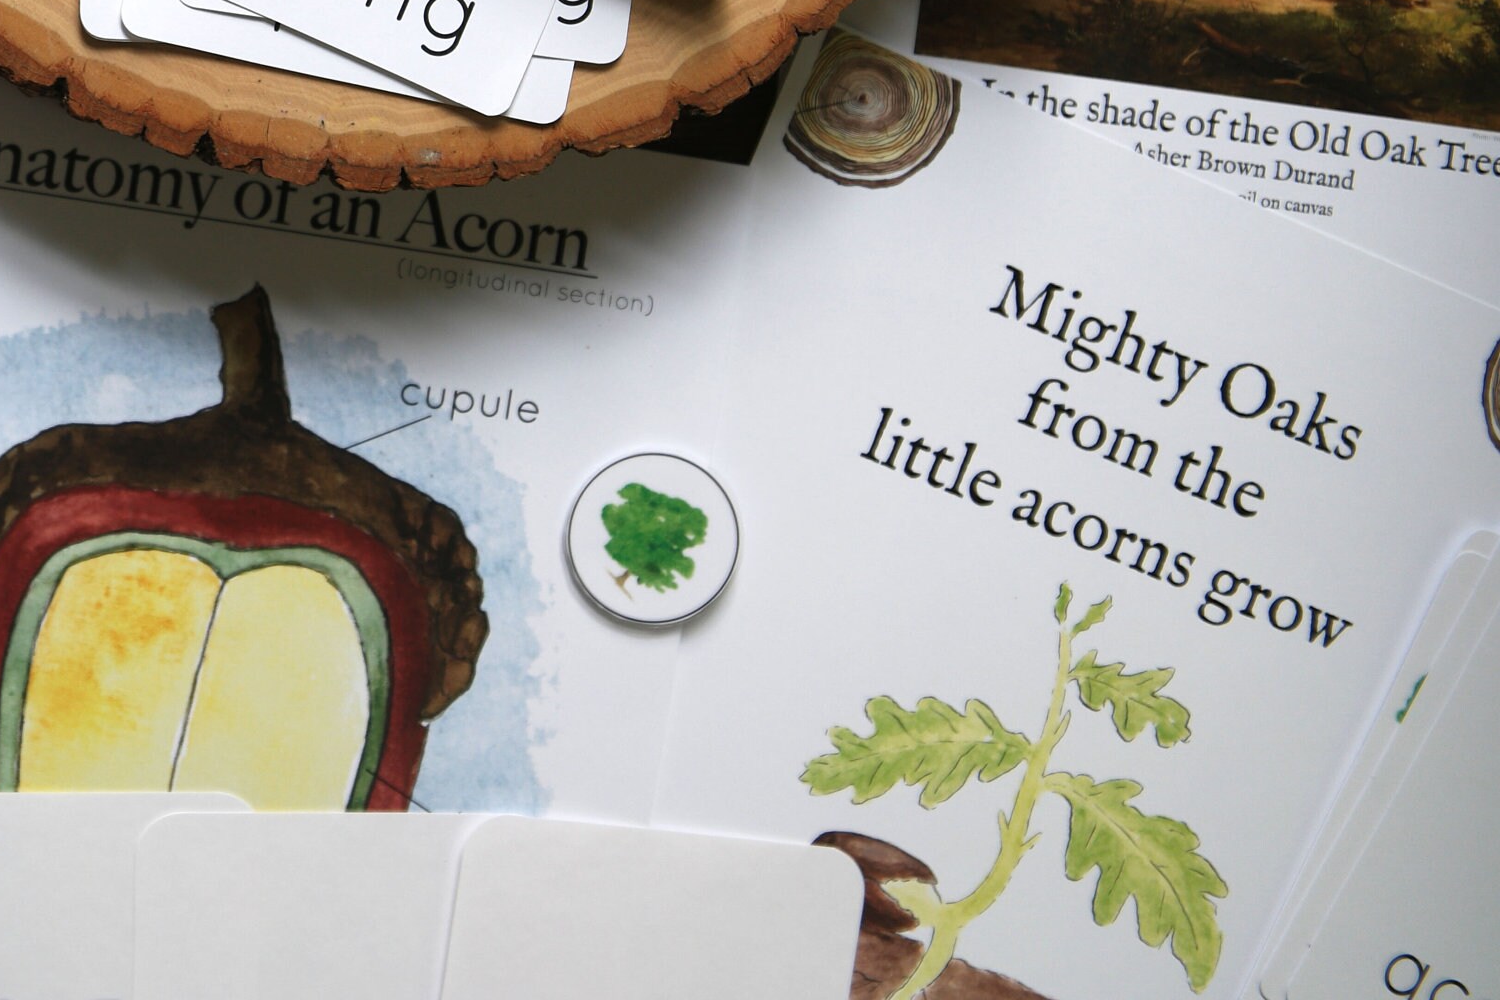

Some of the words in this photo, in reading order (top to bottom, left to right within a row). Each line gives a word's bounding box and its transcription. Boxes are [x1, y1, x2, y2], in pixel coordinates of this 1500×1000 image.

[1027, 84, 1078, 119] the
[1087, 93, 1176, 133] shade
[1185, 108, 1228, 139] of
[1229, 112, 1279, 147] the
[1289, 119, 1351, 157] Old
[1360, 129, 1427, 168] Oak
[1197, 149, 1267, 178] Brown
[1273, 159, 1355, 191] Durand
[1260, 196, 1280, 209] on
[1285, 199, 1334, 217] canvas
[233, 178, 298, 226] of
[310, 192, 381, 238] an
[394, 189, 590, 271] Acorn
[397, 258, 549, 297] (longitudinal
[557, 284, 655, 317] section)
[401, 383, 539, 424] cupule
[988, 265, 1209, 408] Mighty
[1219, 362, 1364, 461] Oaks
[1017, 378, 1160, 477] from
[1173, 445, 1266, 518] the
[860, 407, 1003, 507] little
[1011, 485, 1196, 588] acorns
[1198, 568, 1354, 650] grow
